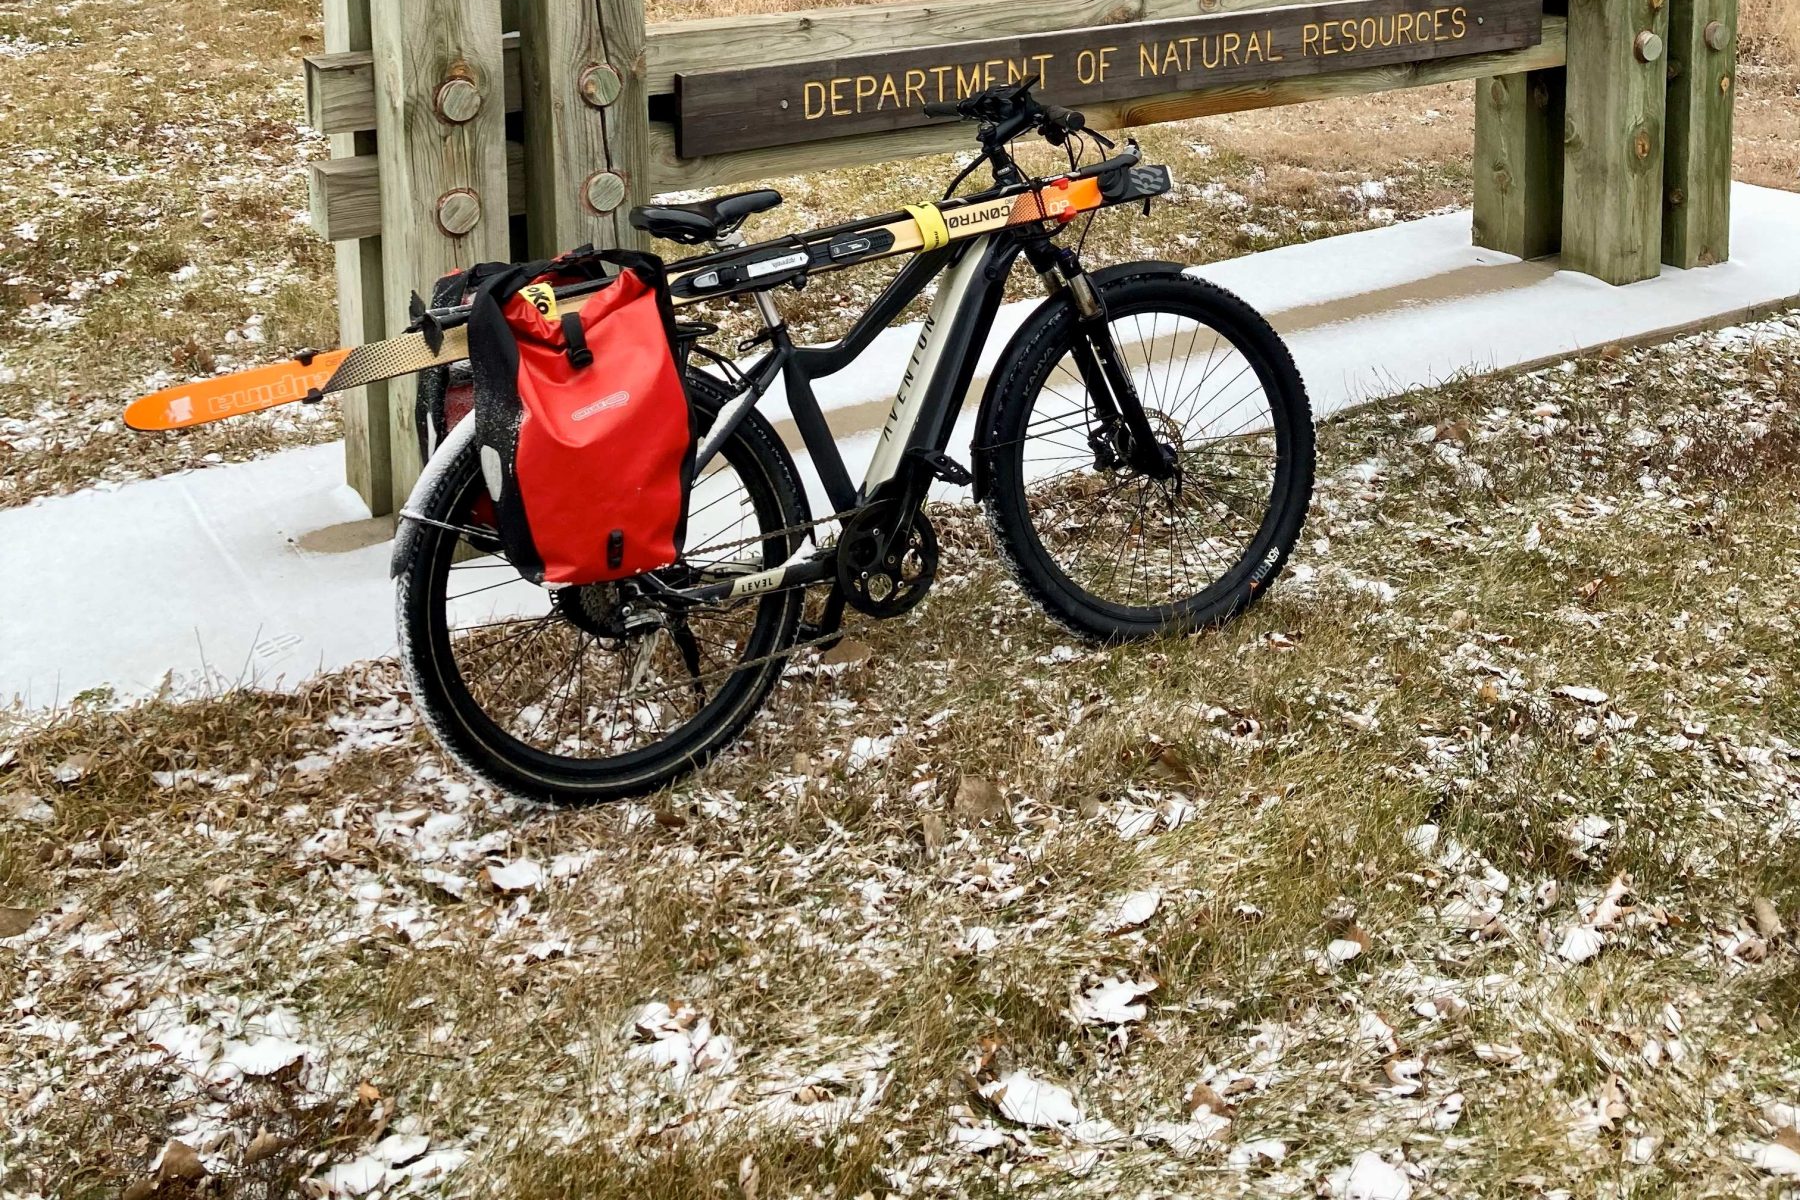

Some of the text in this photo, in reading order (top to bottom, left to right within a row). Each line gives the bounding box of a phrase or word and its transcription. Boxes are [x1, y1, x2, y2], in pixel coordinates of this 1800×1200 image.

[804, 6, 1467, 120] DEPARTMENT OF NATURAL RESOURCES
[883, 314, 935, 442] AVENTON
